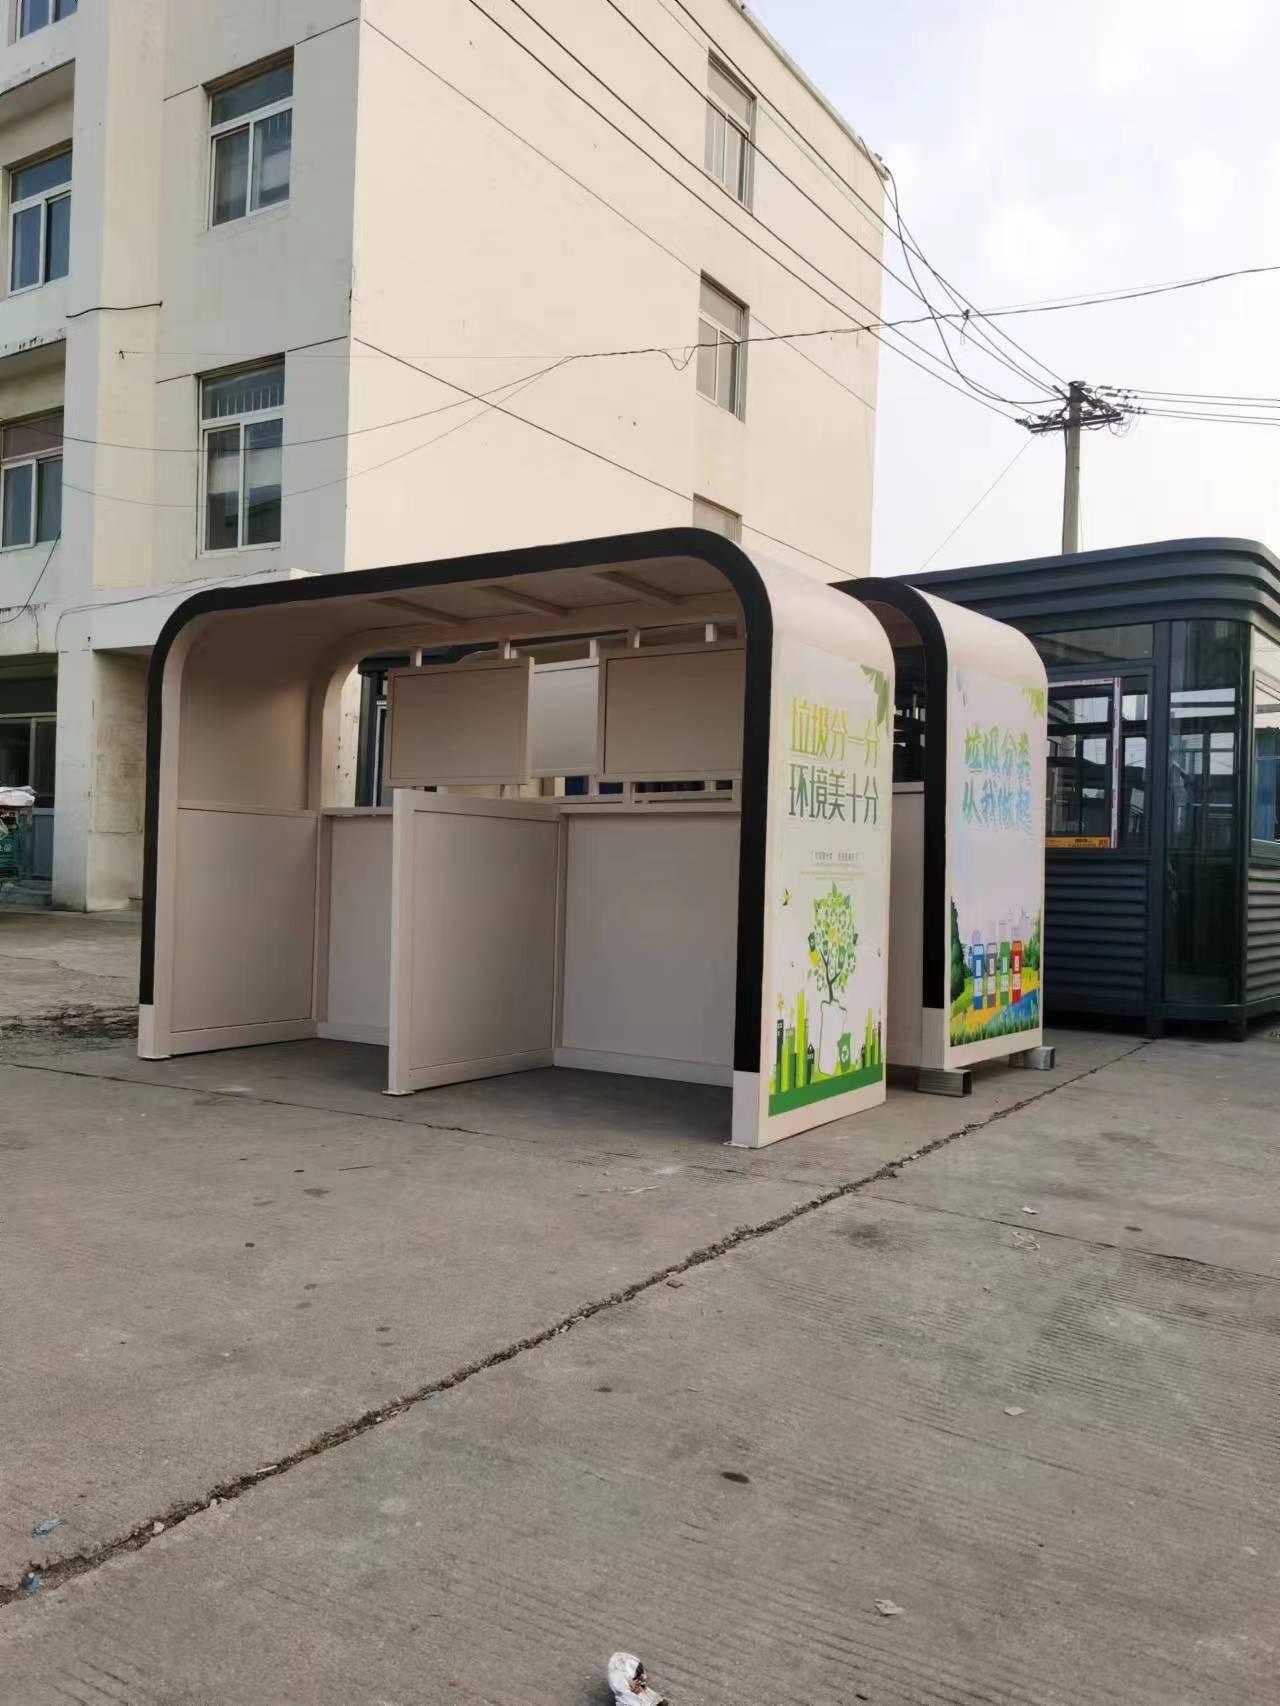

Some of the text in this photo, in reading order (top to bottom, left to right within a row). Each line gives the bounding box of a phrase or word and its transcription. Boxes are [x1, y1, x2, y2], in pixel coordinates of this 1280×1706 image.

[788, 764, 878, 824] 环境美十分
